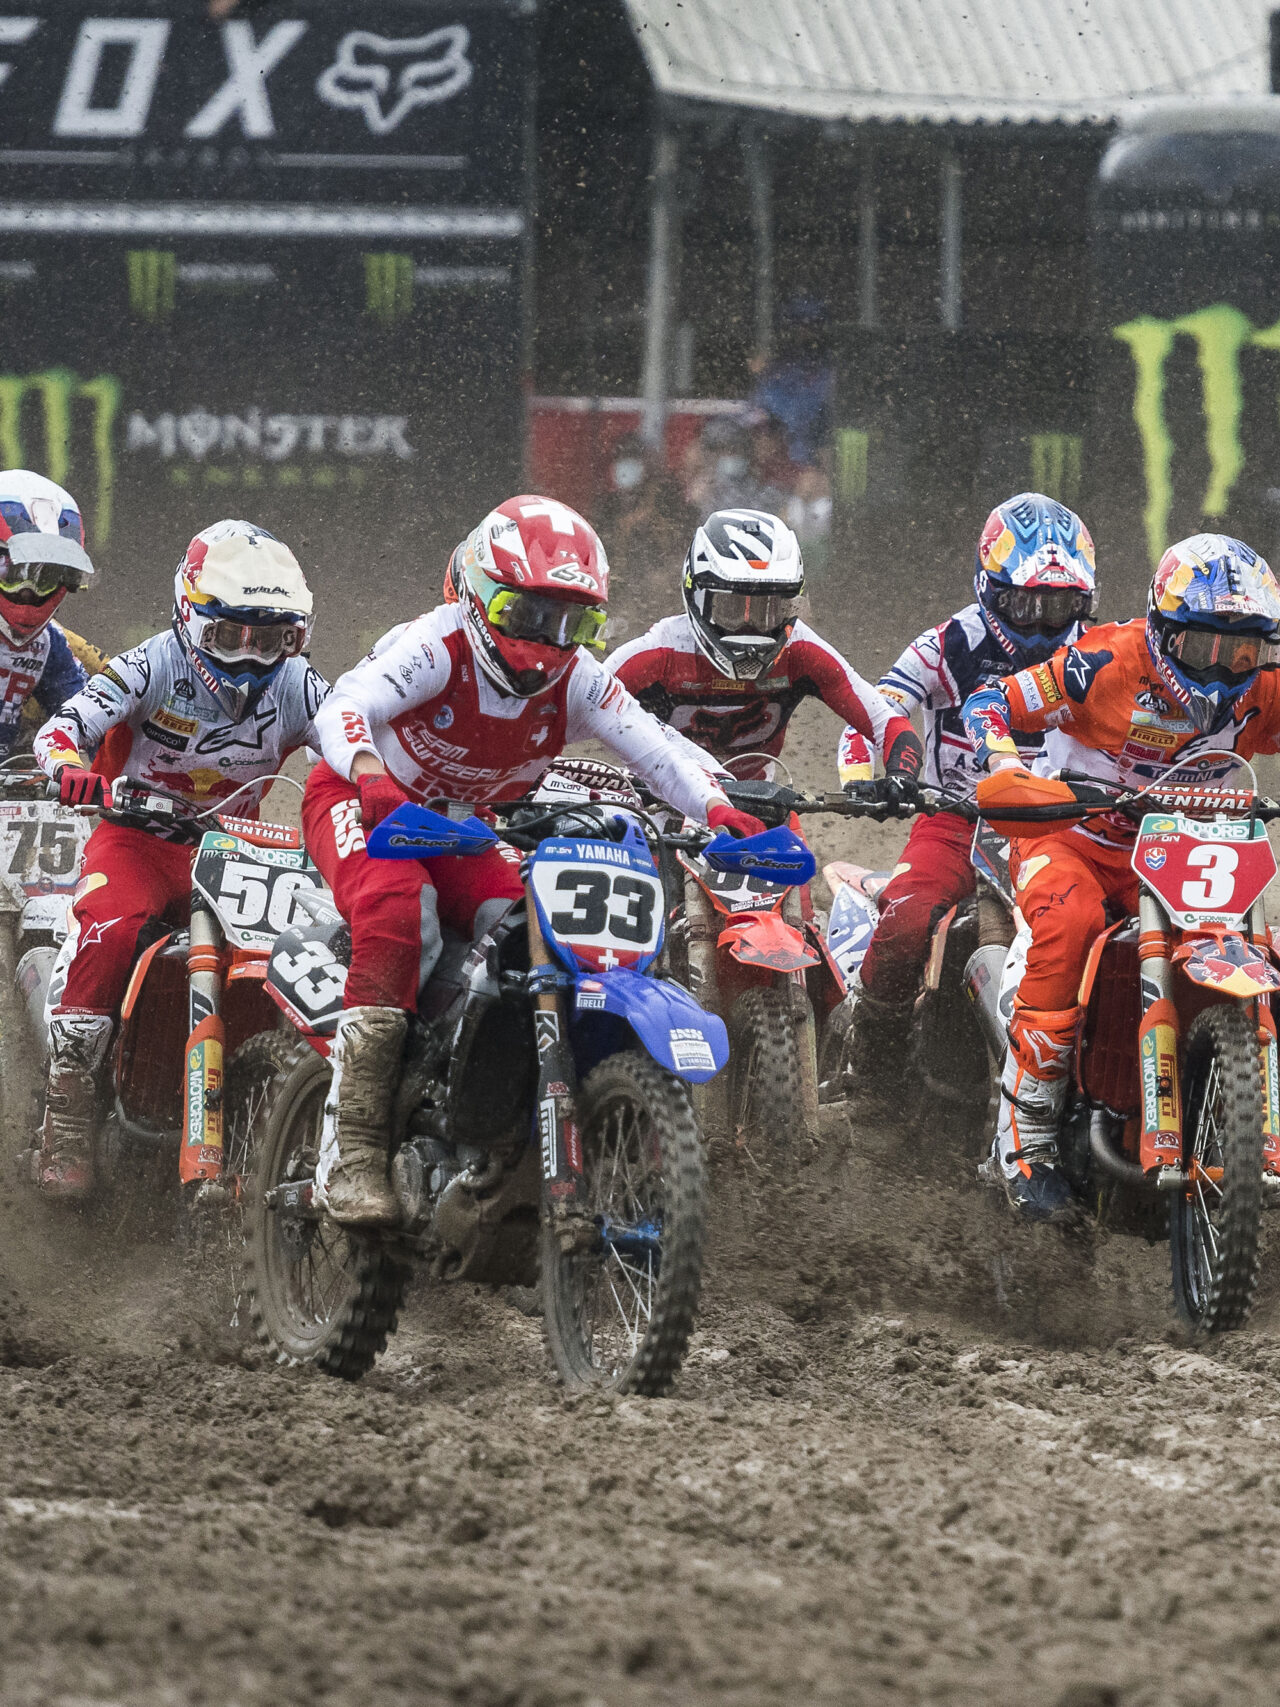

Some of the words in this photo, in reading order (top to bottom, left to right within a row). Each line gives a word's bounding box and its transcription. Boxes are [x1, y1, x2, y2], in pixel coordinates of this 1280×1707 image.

[127, 404, 414, 459] MONSTER
[473, 609, 496, 648] TISSOT
[153, 709, 197, 734] PIRELLI
[410, 720, 470, 761] TEAM
[1131, 729, 1174, 746] PIRELLI
[1149, 793, 1250, 810] RENTHAL
[7, 821, 76, 875] 75
[223, 822, 296, 842] RENTHAL
[388, 834, 460, 847] Polisport
[576, 844, 631, 867] YAMAHA
[743, 857, 805, 870] Polisport
[1181, 844, 1240, 909] 3
[551, 869, 656, 944] 33
[272, 940, 349, 1011] 33
[577, 991, 607, 1009] PIRELLI
[189, 1071, 203, 1143] MOTOREX
[1143, 1056, 1158, 1129] MOTOREX
[539, 1098, 558, 1179] PIRELLI
